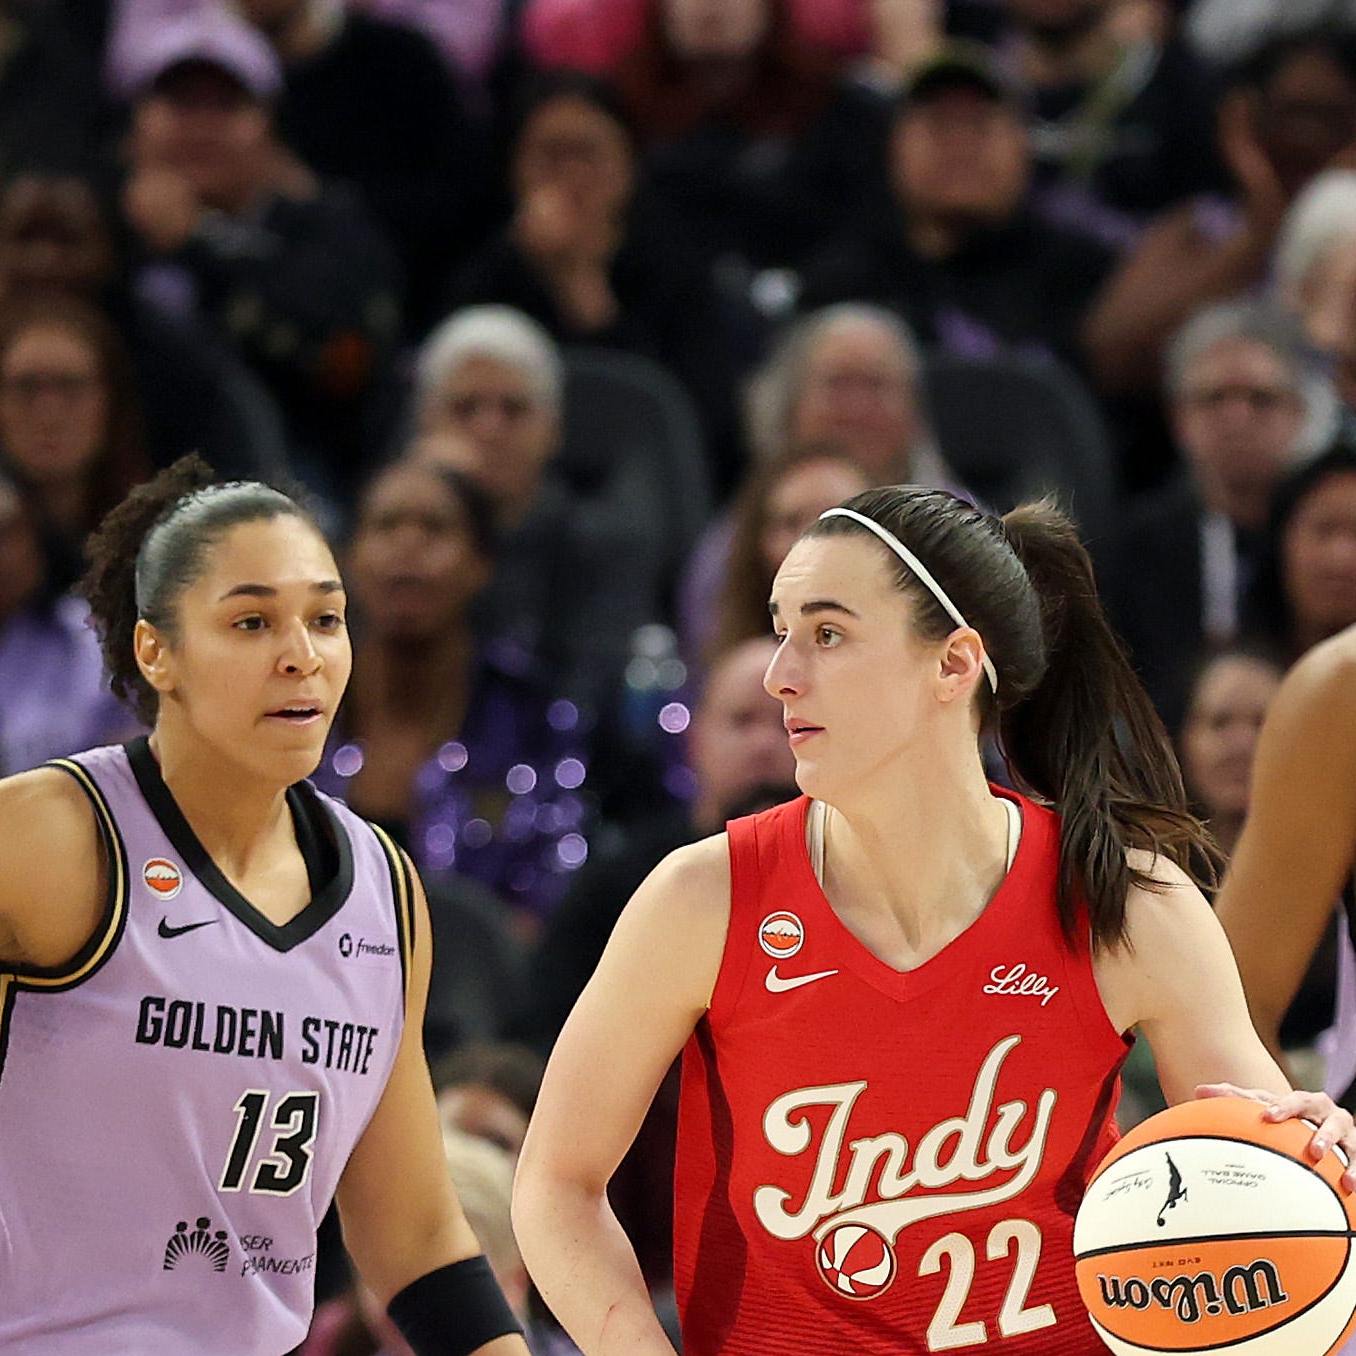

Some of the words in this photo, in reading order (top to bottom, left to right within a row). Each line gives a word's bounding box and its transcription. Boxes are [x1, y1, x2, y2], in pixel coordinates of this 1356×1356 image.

[983, 962, 1060, 1006] Lilly
[135, 995, 285, 1062] GOLDEN
[301, 1015, 380, 1076] STATE
[217, 1087, 321, 1198] 13
[752, 1033, 1059, 1243] Indy
[916, 1218, 1058, 1353] 22
[1096, 1255, 1289, 1324] Wilson
